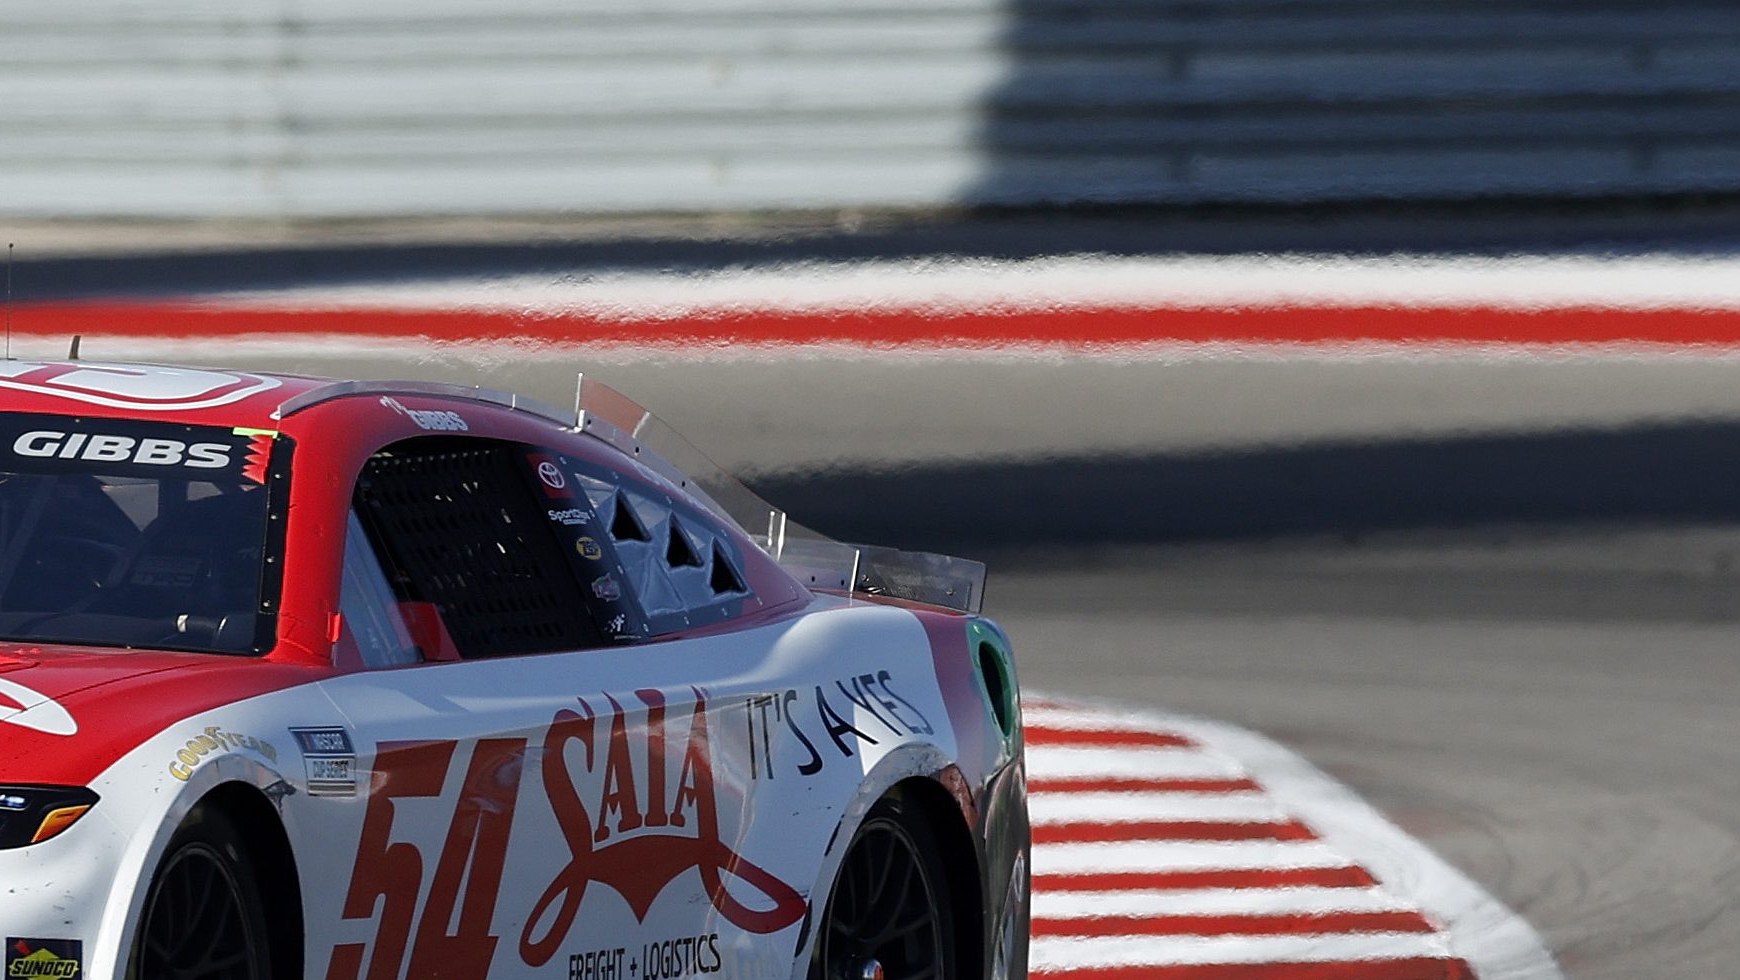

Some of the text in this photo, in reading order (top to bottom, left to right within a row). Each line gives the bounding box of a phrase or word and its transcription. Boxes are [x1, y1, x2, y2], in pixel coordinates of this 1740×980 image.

[12, 430, 232, 469] GIBBS
[746, 669, 935, 780] IT'S A YES
[168, 726, 278, 782] GOODYEAR
[11, 959, 76, 977] SUNOCO
[629, 956, 638, 977] +
